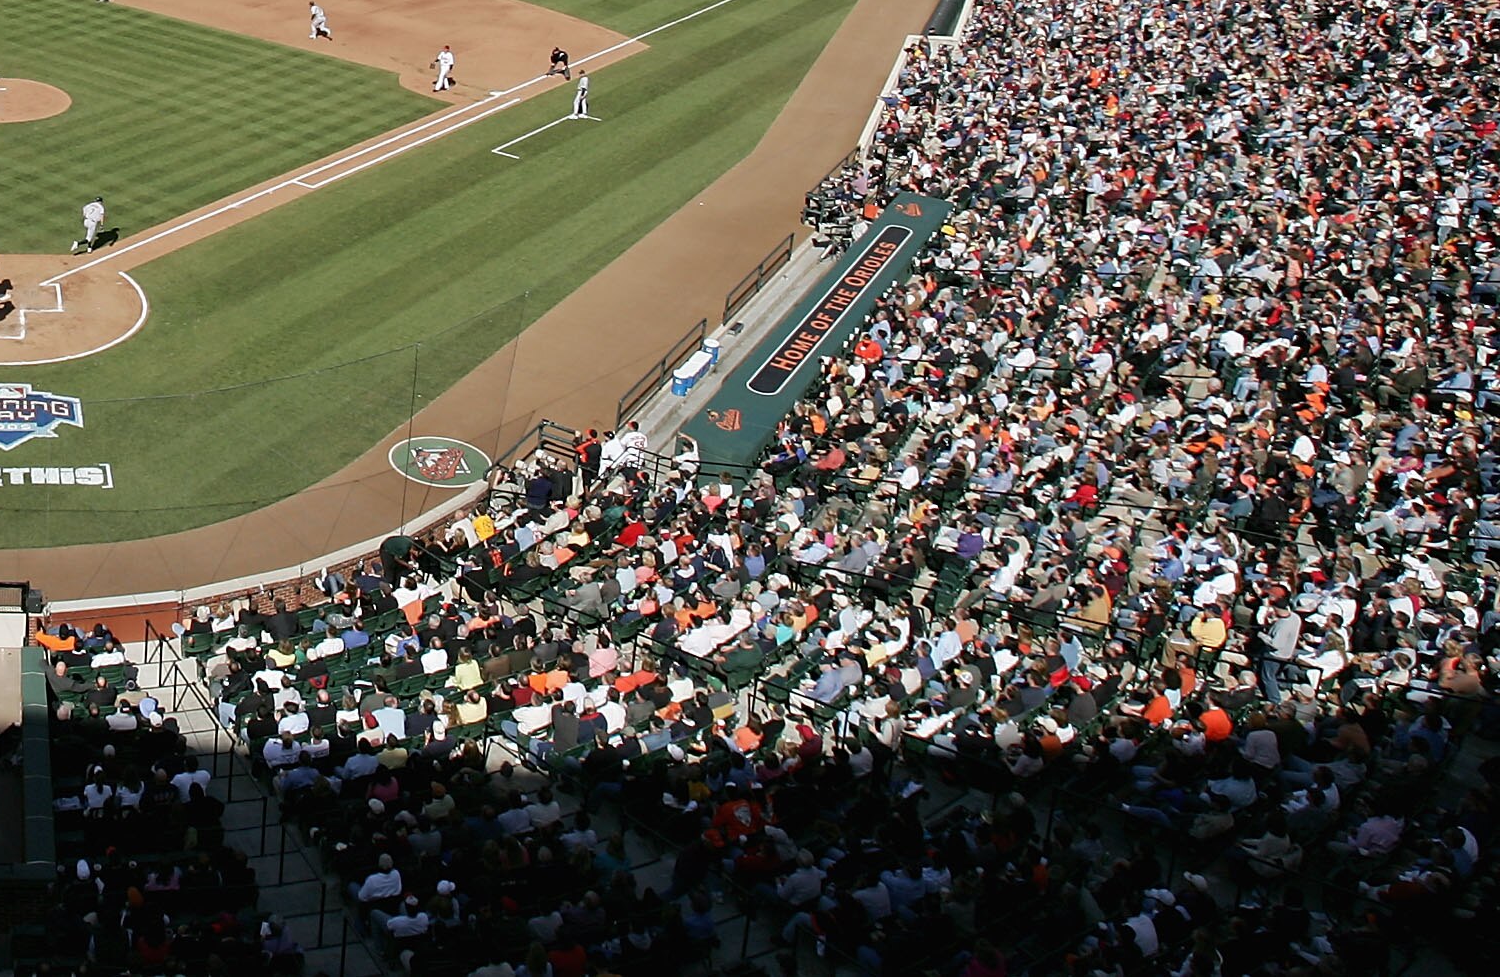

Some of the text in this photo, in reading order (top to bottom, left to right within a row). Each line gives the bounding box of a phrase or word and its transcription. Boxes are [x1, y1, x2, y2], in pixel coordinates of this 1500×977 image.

[770, 240, 898, 372] HOME OF THE ORIOLES
